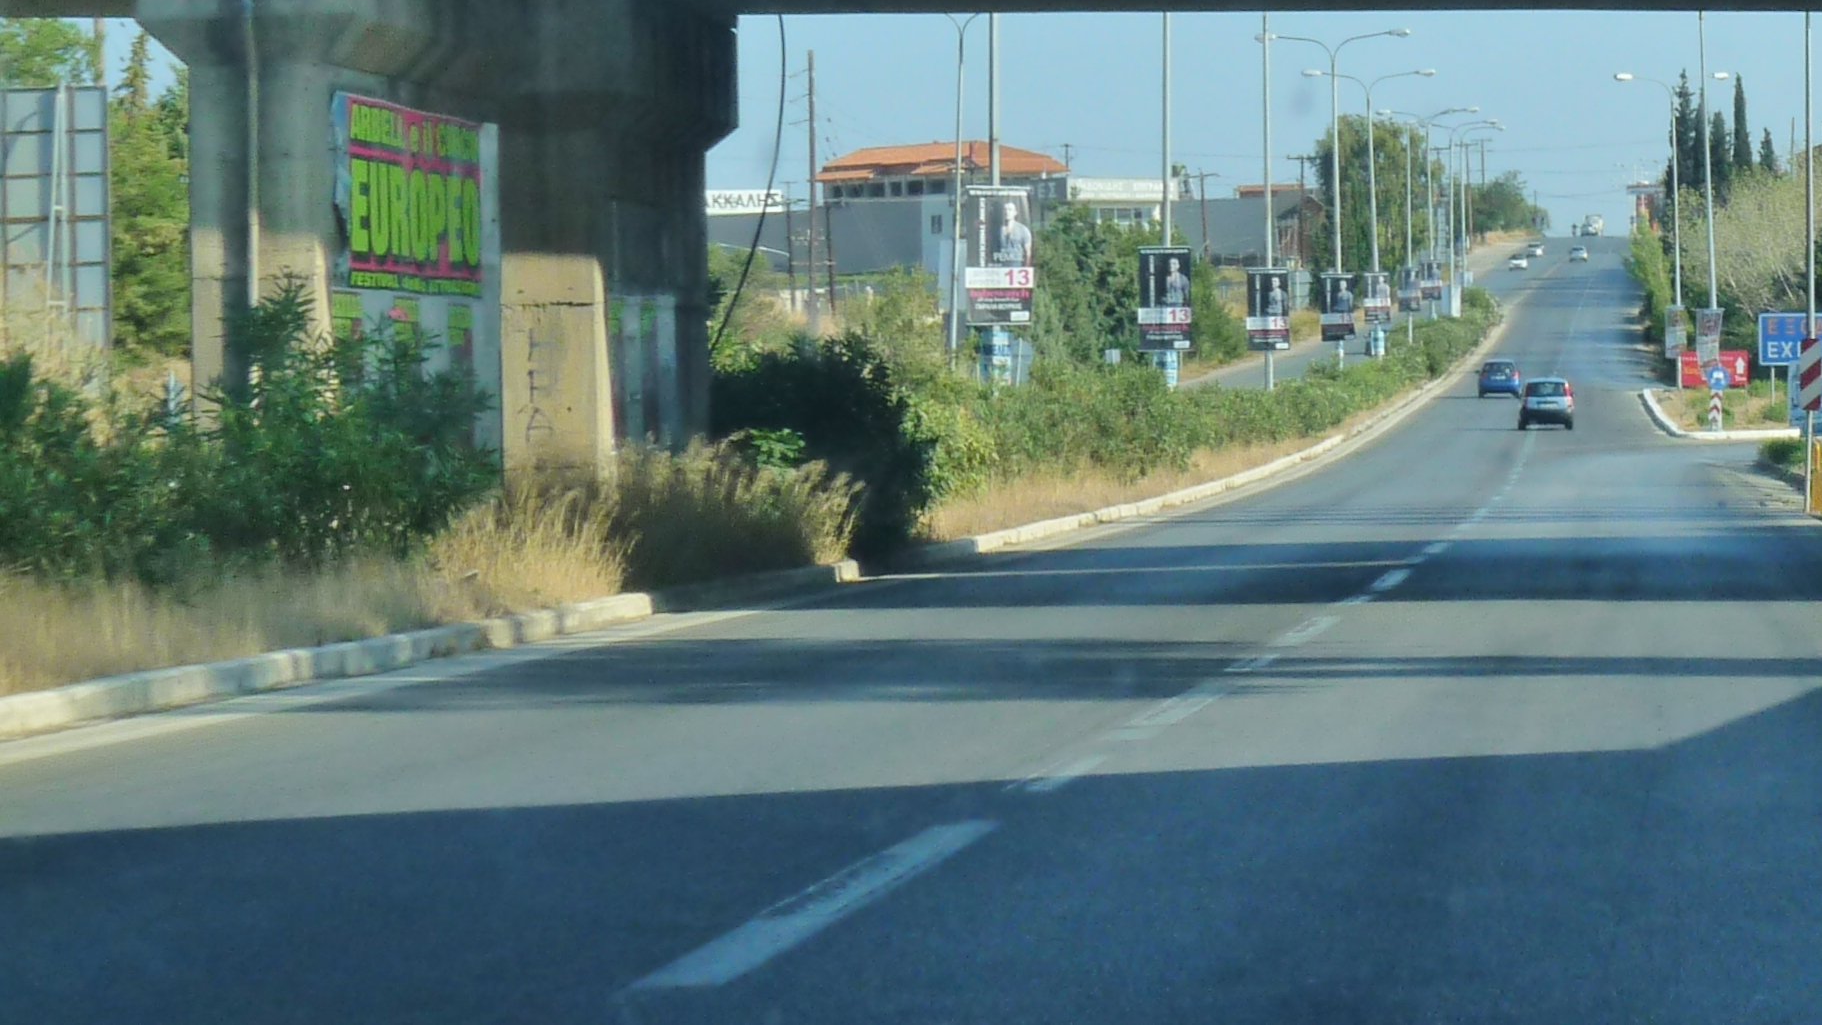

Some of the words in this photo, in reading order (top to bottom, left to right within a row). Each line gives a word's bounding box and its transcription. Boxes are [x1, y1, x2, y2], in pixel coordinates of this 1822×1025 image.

[706, 192, 783, 209] ΚΚΑΛΗΣ
[1005, 269, 1029, 286] 13
[1169, 308, 1190, 322] 13
[1270, 317, 1288, 328] 13
